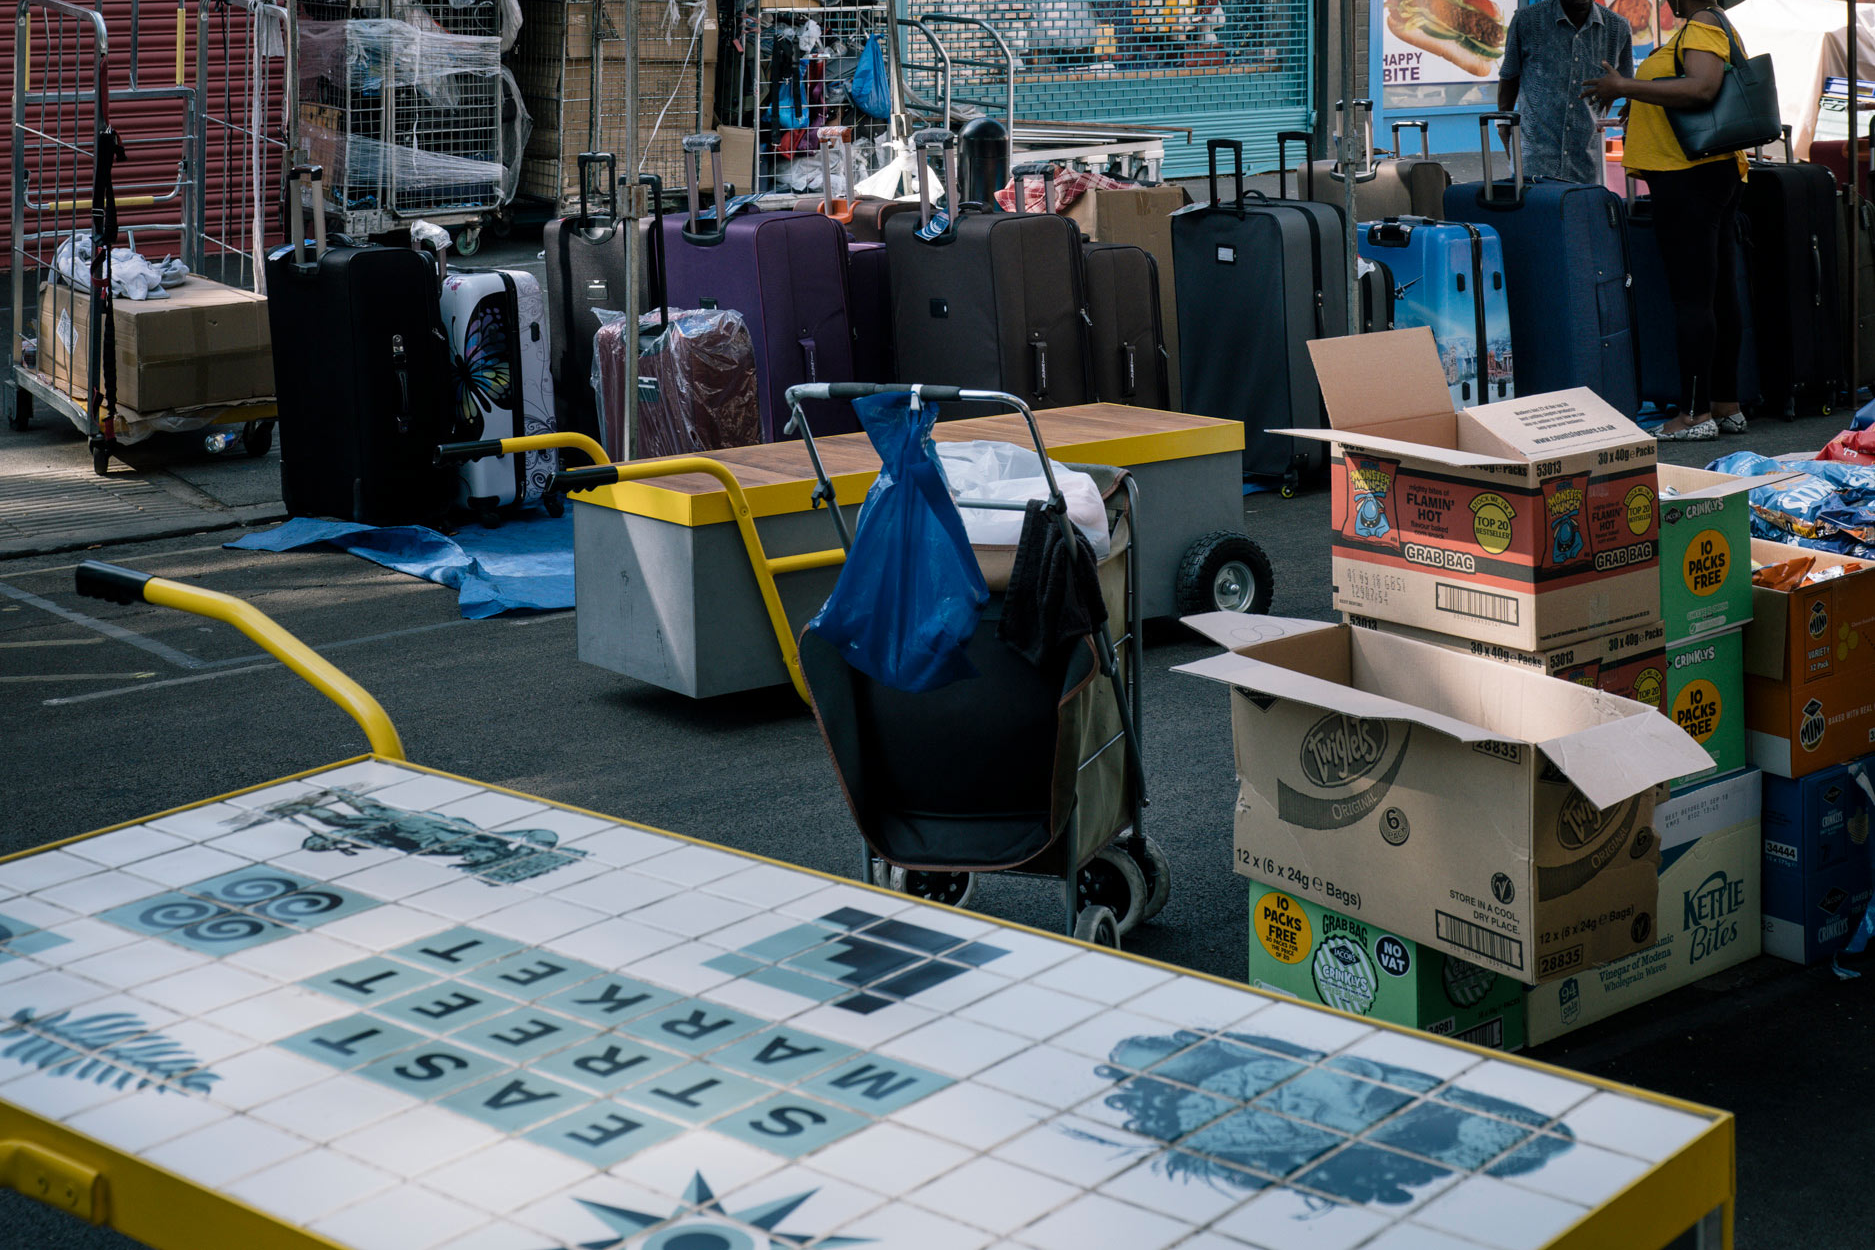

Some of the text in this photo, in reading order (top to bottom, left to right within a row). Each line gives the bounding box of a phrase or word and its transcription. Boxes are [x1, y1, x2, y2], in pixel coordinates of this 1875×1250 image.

[1382, 66, 1420, 83] BITE
[1598, 445, 1655, 465] 30 x 40g Packs
[1351, 469, 1391, 486] MONSTER
[1537, 461, 1562, 477] 53013
[1406, 493, 1455, 511] FLAMIN'
[1547, 489, 1583, 508] MONSTER
[1686, 498, 1724, 520] CRINKLYS
[1418, 507, 1442, 523] HOT
[1592, 507, 1623, 523] FLAMIN'
[1629, 504, 1650, 517] TOP 20
[1476, 527, 1511, 540] BESTSELLER
[1477, 516, 1508, 531] TOP 20
[1600, 519, 1615, 531] HOT
[1405, 544, 1475, 572] GRAB BAG
[1596, 542, 1653, 570] GRAB BAG
[1701, 540, 1713, 556] 10
[1689, 552, 1726, 576] PACKS
[1694, 569, 1722, 591] FREE
[1809, 614, 1827, 634] MINI
[1609, 638, 1618, 652] 30
[1625, 633, 1638, 646] 40g
[1645, 627, 1663, 641] Packs
[1470, 641, 1483, 655] 30
[1491, 647, 1509, 662] 40g
[1517, 653, 1542, 668] Packs
[1550, 651, 1574, 668] 53013
[1675, 645, 1715, 669] CRINKLYS
[1808, 645, 1830, 660] VARIETY
[1639, 689, 1650, 699] TOP
[1690, 689, 1703, 706] 10
[1677, 701, 1717, 726] PACKS
[1800, 716, 1825, 744] MINI
[1307, 715, 1377, 784] Twiglets
[1332, 792, 1377, 821] ORIGINAL
[1386, 808, 1400, 831] 6
[1563, 798, 1604, 846] Twig
[1591, 825, 1630, 870] ORIGINAL
[1766, 841, 1796, 859] 34444
[1236, 848, 1362, 910] 12 x (6 x 24g Bags)
[1276, 895, 1289, 912] 10
[1450, 889, 1520, 925] STORE IN A COOL,
[1683, 871, 1746, 932] KETTLE
[1264, 906, 1302, 932] PACKS
[1473, 910, 1521, 936] DRY PLACE.
[1540, 904, 1634, 944] 12 x (6 x 24g Bags)
[1269, 924, 1297, 946] FREE
[1322, 913, 1368, 950] GRAB BAG
[1689, 918, 1738, 966] Bites
[1383, 941, 1402, 958] NO
[1381, 953, 1406, 973] VAT
[1541, 949, 1580, 974] 28835
[1599, 961, 1632, 984] Vinegar
[1631, 956, 1641, 973] of
[1641, 948, 1672, 969] Modena
[1322, 964, 1369, 993] CRINKLYS
[1603, 962, 1668, 994] Wholegrain Waves
[1561, 981, 1577, 1003] 94
